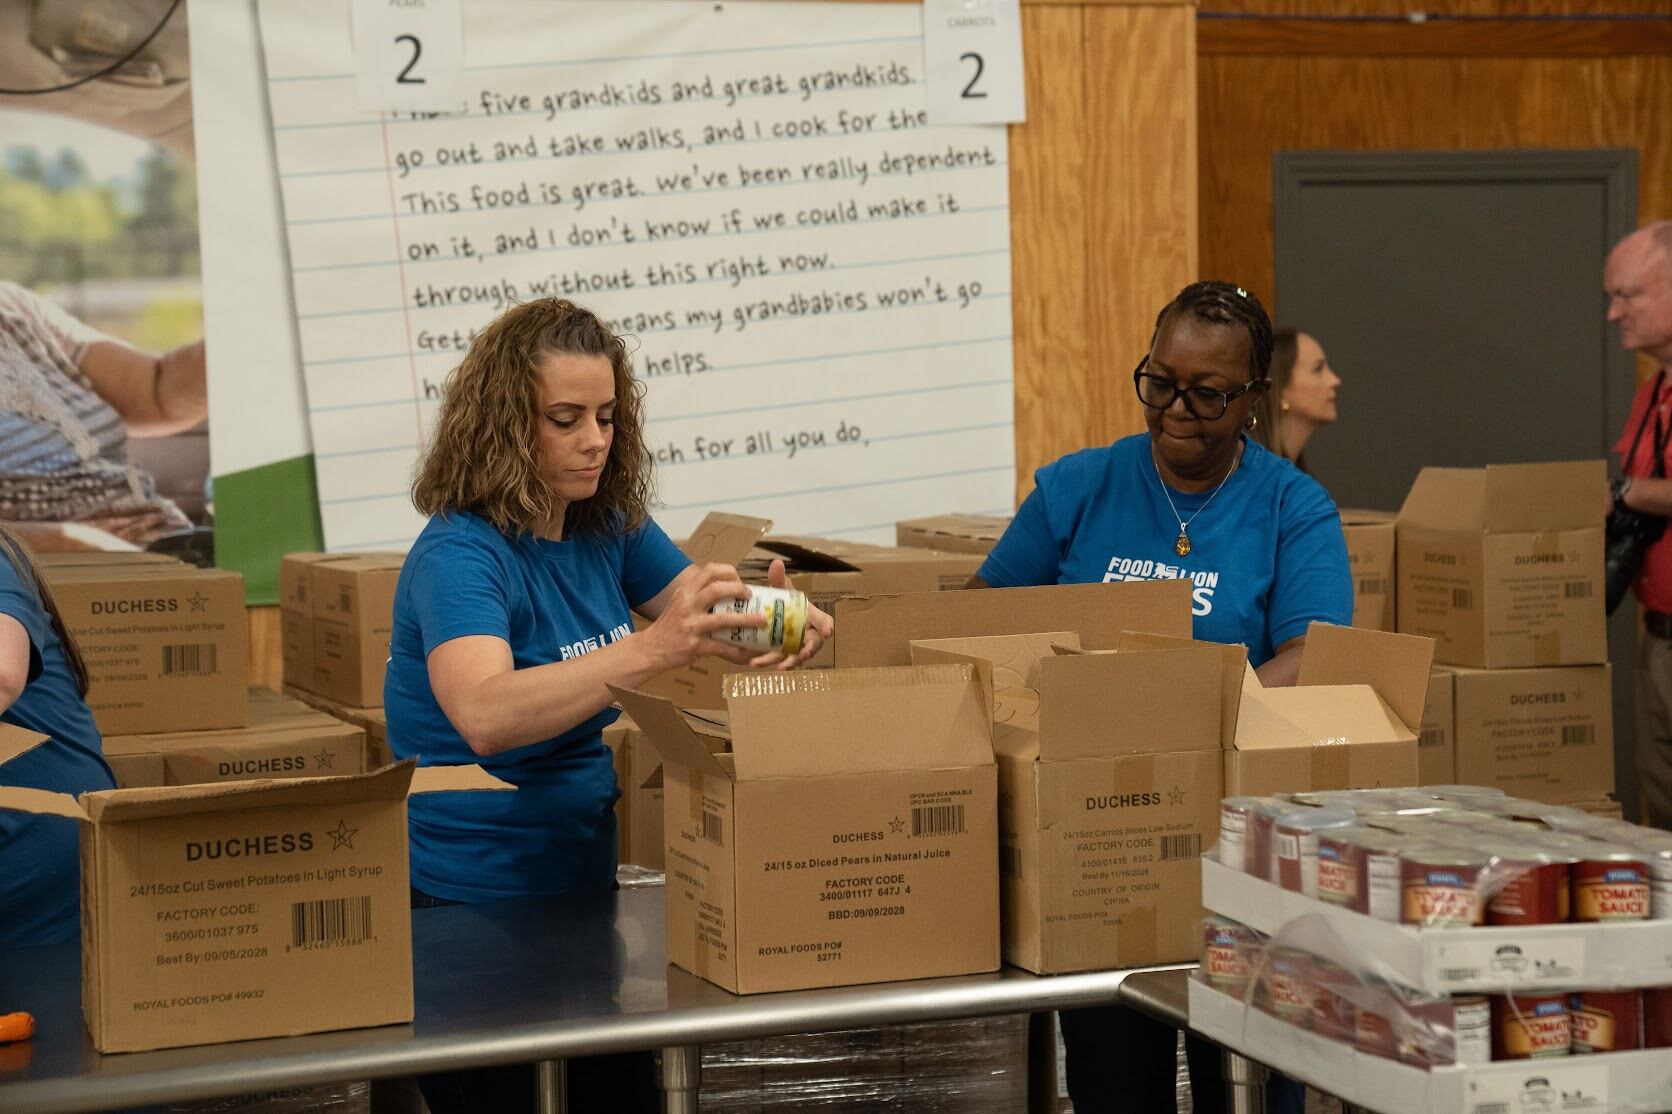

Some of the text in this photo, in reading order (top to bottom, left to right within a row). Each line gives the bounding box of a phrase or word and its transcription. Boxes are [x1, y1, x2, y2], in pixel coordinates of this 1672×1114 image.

[394, 33, 426, 84] 2
[959, 51, 987, 99] 2
[480, 92, 531, 118] five
[542, 83, 662, 120] grandkids
[672, 76, 714, 102] and
[723, 74, 790, 106] great
[396, 107, 928, 178] go out and take walks, and I cook for the
[403, 190, 459, 215] This
[470, 182, 529, 211] food
[541, 179, 561, 203] is
[571, 176, 646, 210] great.
[739, 163, 792, 187] been
[802, 156, 868, 185] really
[879, 146, 996, 177] dependent
[408, 193, 960, 262] on it, and I don't know if we could make it
[413, 251, 836, 310] through without this right now.
[685, 308, 725, 333] my
[733, 291, 869, 325] grandbabies
[876, 276, 950, 308] won't
[956, 278, 983, 308] go
[645, 350, 713, 378] helps.
[694, 436, 735, 461] for
[745, 431, 773, 456] all
[783, 430, 826, 459] you
[836, 420, 870, 448] do,
[1515, 553, 1564, 566] DUCHESS
[1108, 557, 1219, 589] FOOD LION
[91, 599, 178, 615] DUCHESS
[1511, 691, 1567, 705] DUCHESS
[219, 756, 305, 777] DUCHESS
[1086, 791, 1161, 811] DUCHESS
[186, 831, 315, 863] DUCHESS
[832, 831, 885, 845] DUCHESS
[1077, 838, 1155, 854] FACTORY CODE
[764, 848, 951, 873] 24/15 oz Diced Pears in Natural Juice
[129, 865, 384, 899] 24/15oz Cut Sweet Potatoes in Light Syrup
[825, 874, 905, 890] FACTORY CODE
[1072, 883, 1161, 898] COUNTRY OF ORIGIN
[819, 889, 872, 902] 3400/01117
[905, 885, 912, 895] 4
[156, 903, 260, 923] FACTORY CODE:
[828, 906, 905, 921] BBD:09/09/2028
[1600, 902, 1643, 913] SAUCE
[236, 924, 259, 937] 975
[758, 941, 842, 957] ROYAL FOODS PO#
[817, 952, 842, 963] 52771
[155, 952, 182, 967] Best
[133, 1000, 169, 1012] ROYAL
[171, 995, 209, 1008] FOODS
